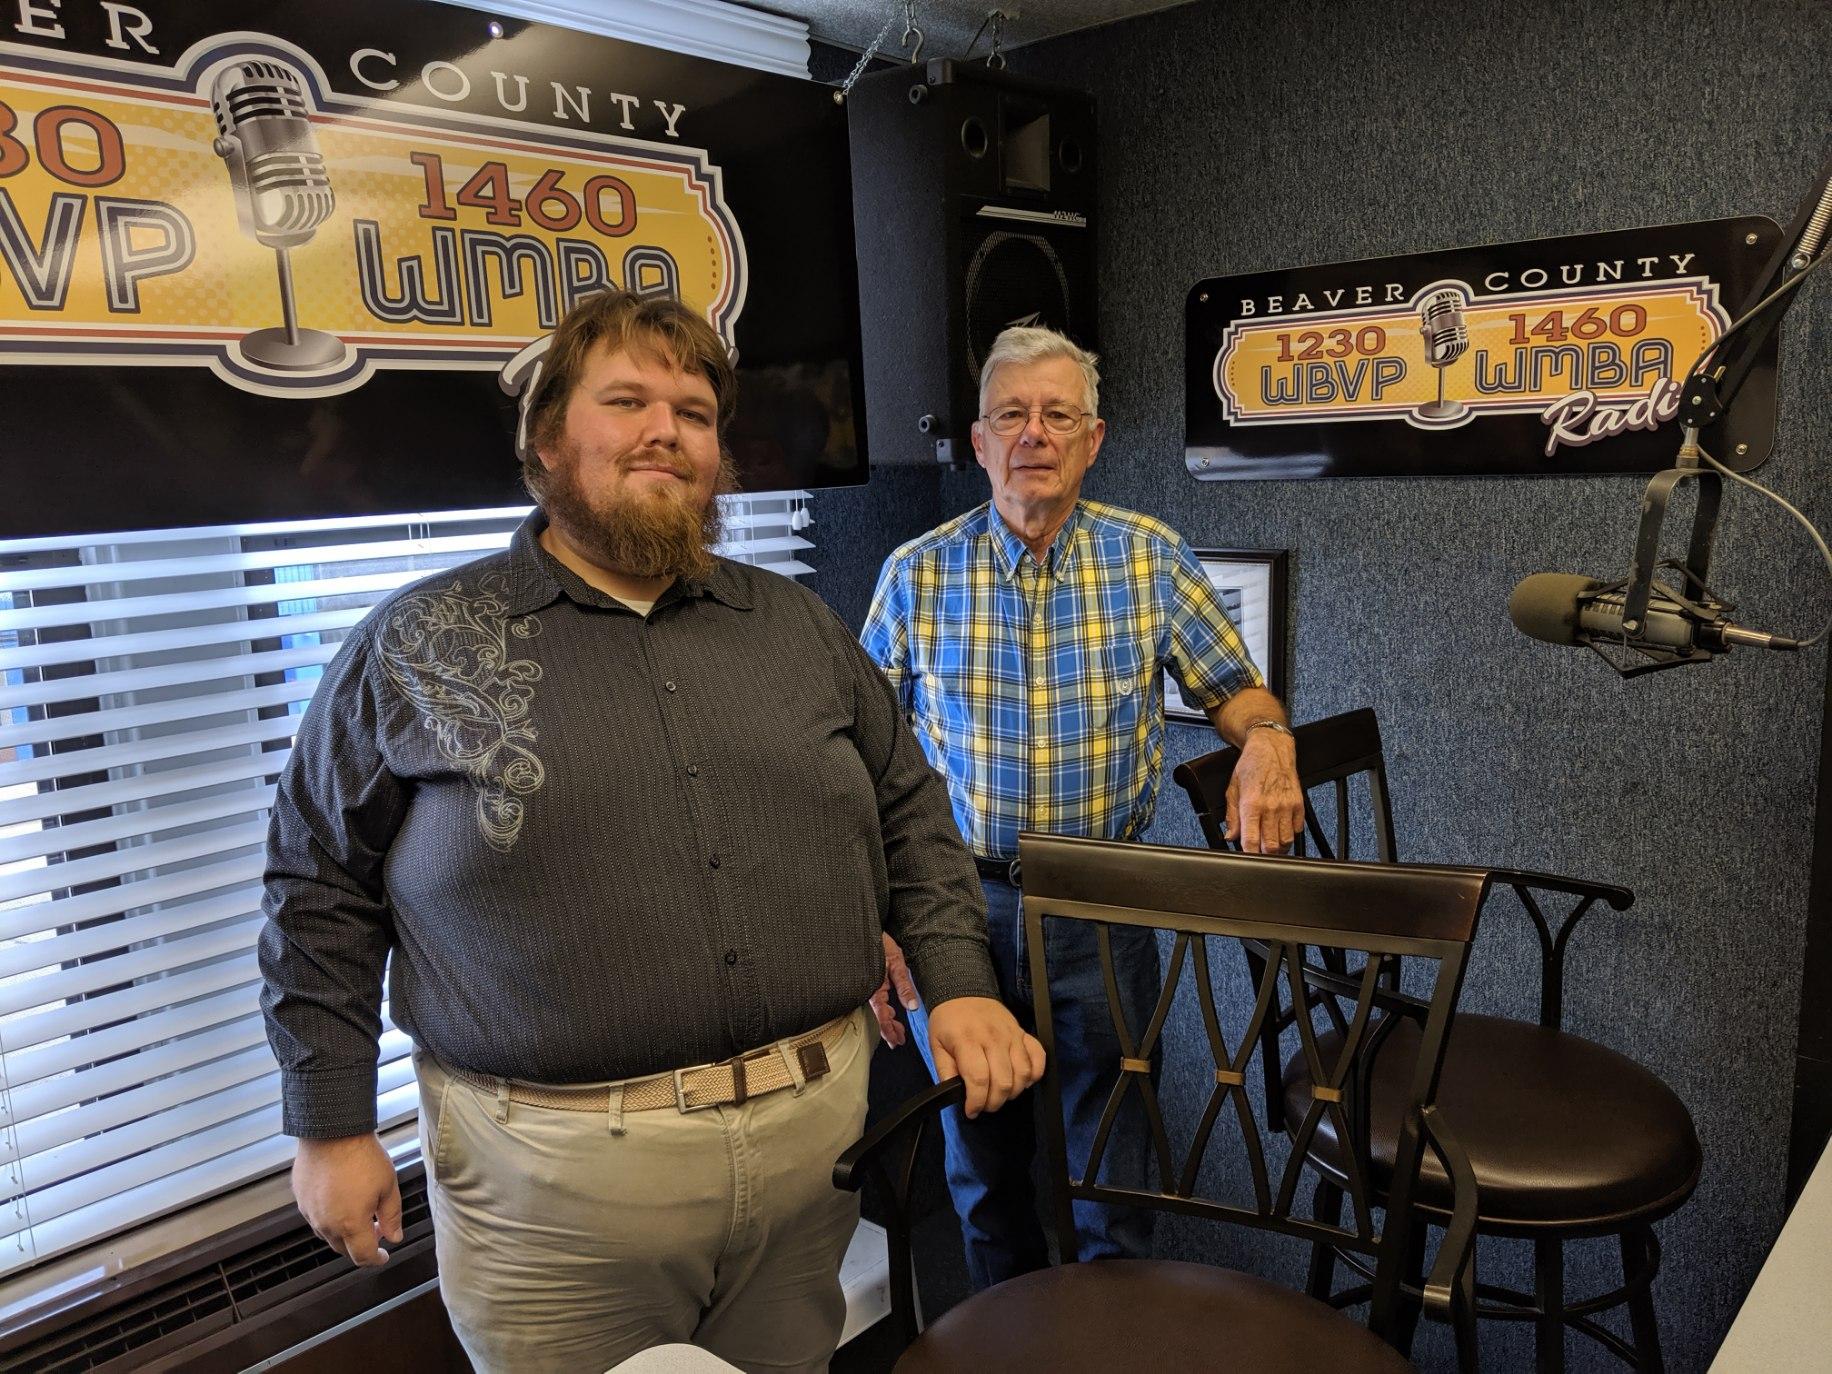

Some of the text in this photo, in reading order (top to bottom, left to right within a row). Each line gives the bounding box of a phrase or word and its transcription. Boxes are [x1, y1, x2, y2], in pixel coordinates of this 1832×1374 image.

[350, 48, 686, 137] COUNTY
[410, 151, 637, 237] 1460
[1240, 253, 1695, 316] BEAVER COUNTY
[1276, 326, 1386, 362] 1230
[1509, 304, 1647, 345] 1460
[1261, 356, 1407, 406] WBVP
[1475, 338, 1674, 394] WMBA
[1541, 377, 1681, 457] Radi
